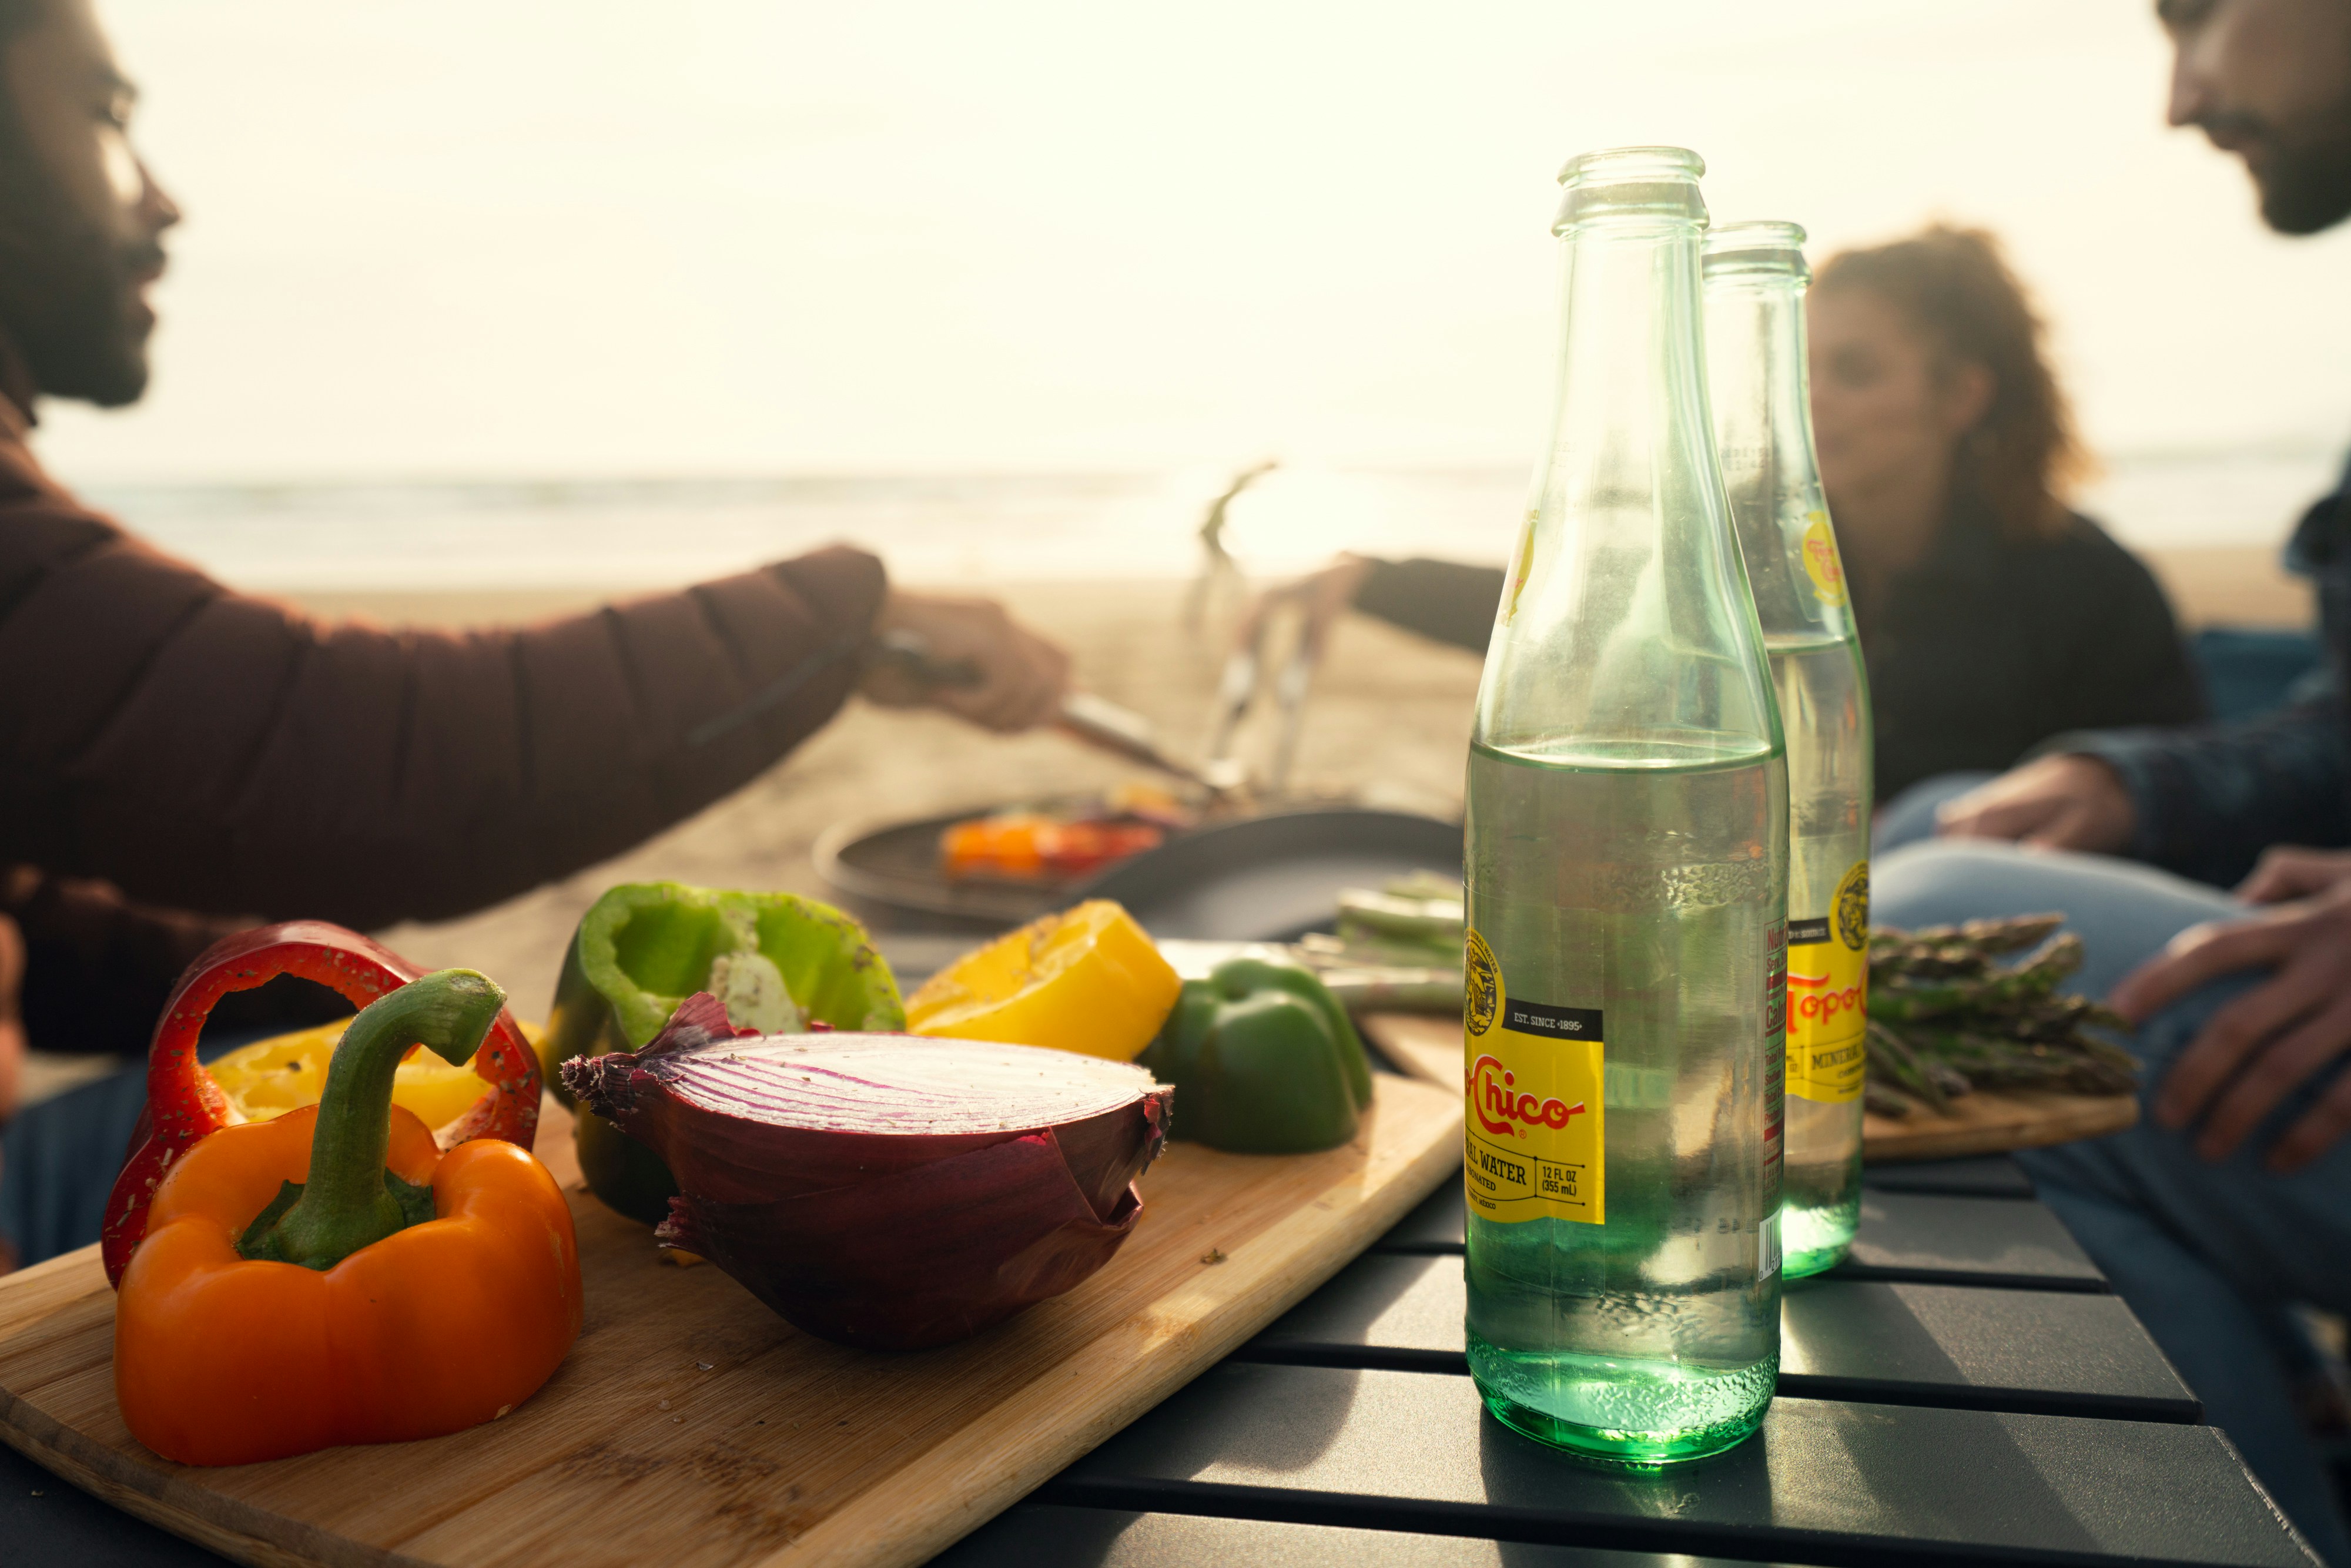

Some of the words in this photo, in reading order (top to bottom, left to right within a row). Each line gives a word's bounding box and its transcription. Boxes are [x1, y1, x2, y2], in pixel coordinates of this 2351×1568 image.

[1484, 947, 1498, 974] WATER
[1514, 1012, 1529, 1024] EST.
[1531, 1016, 1556, 1028] SINCE
[1473, 1054, 1586, 1137] Chico
[1480, 1150, 1527, 1185] WATER
[1543, 1166, 1552, 1179] 12
[1555, 1168, 1563, 1181] FL
[1566, 1171, 1577, 1182] OZ
[1542, 1180, 1559, 1192] (355
[1561, 1184, 1577, 1197] mL)
